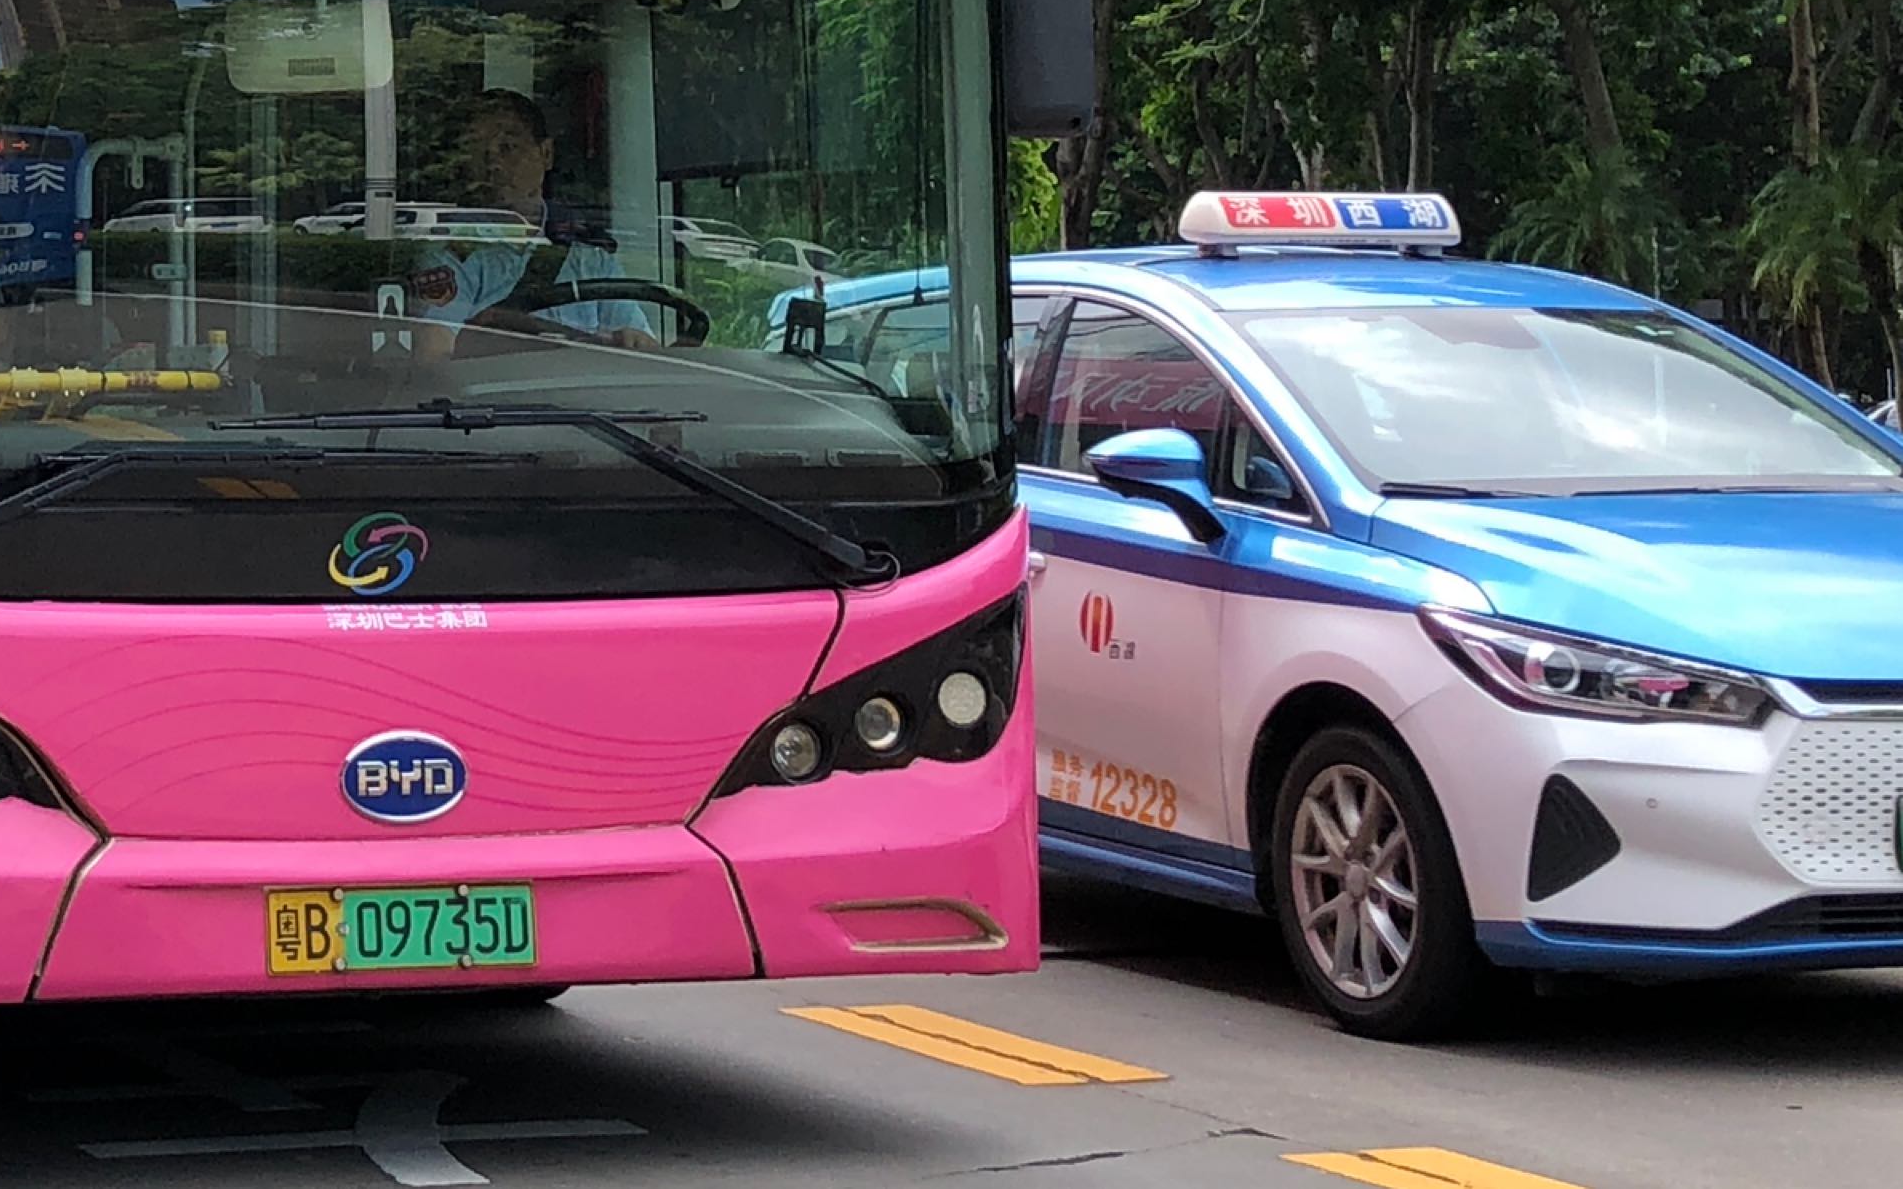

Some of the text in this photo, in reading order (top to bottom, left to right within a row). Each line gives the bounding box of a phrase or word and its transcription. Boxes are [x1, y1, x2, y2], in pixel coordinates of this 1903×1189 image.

[1229, 197, 1446, 227] 深圳西湖
[327, 611, 488, 630] 深圳巴士集团
[356, 759, 456, 797] BYD
[1090, 761, 1178, 829] 12328
[356, 897, 530, 959] 09735D
